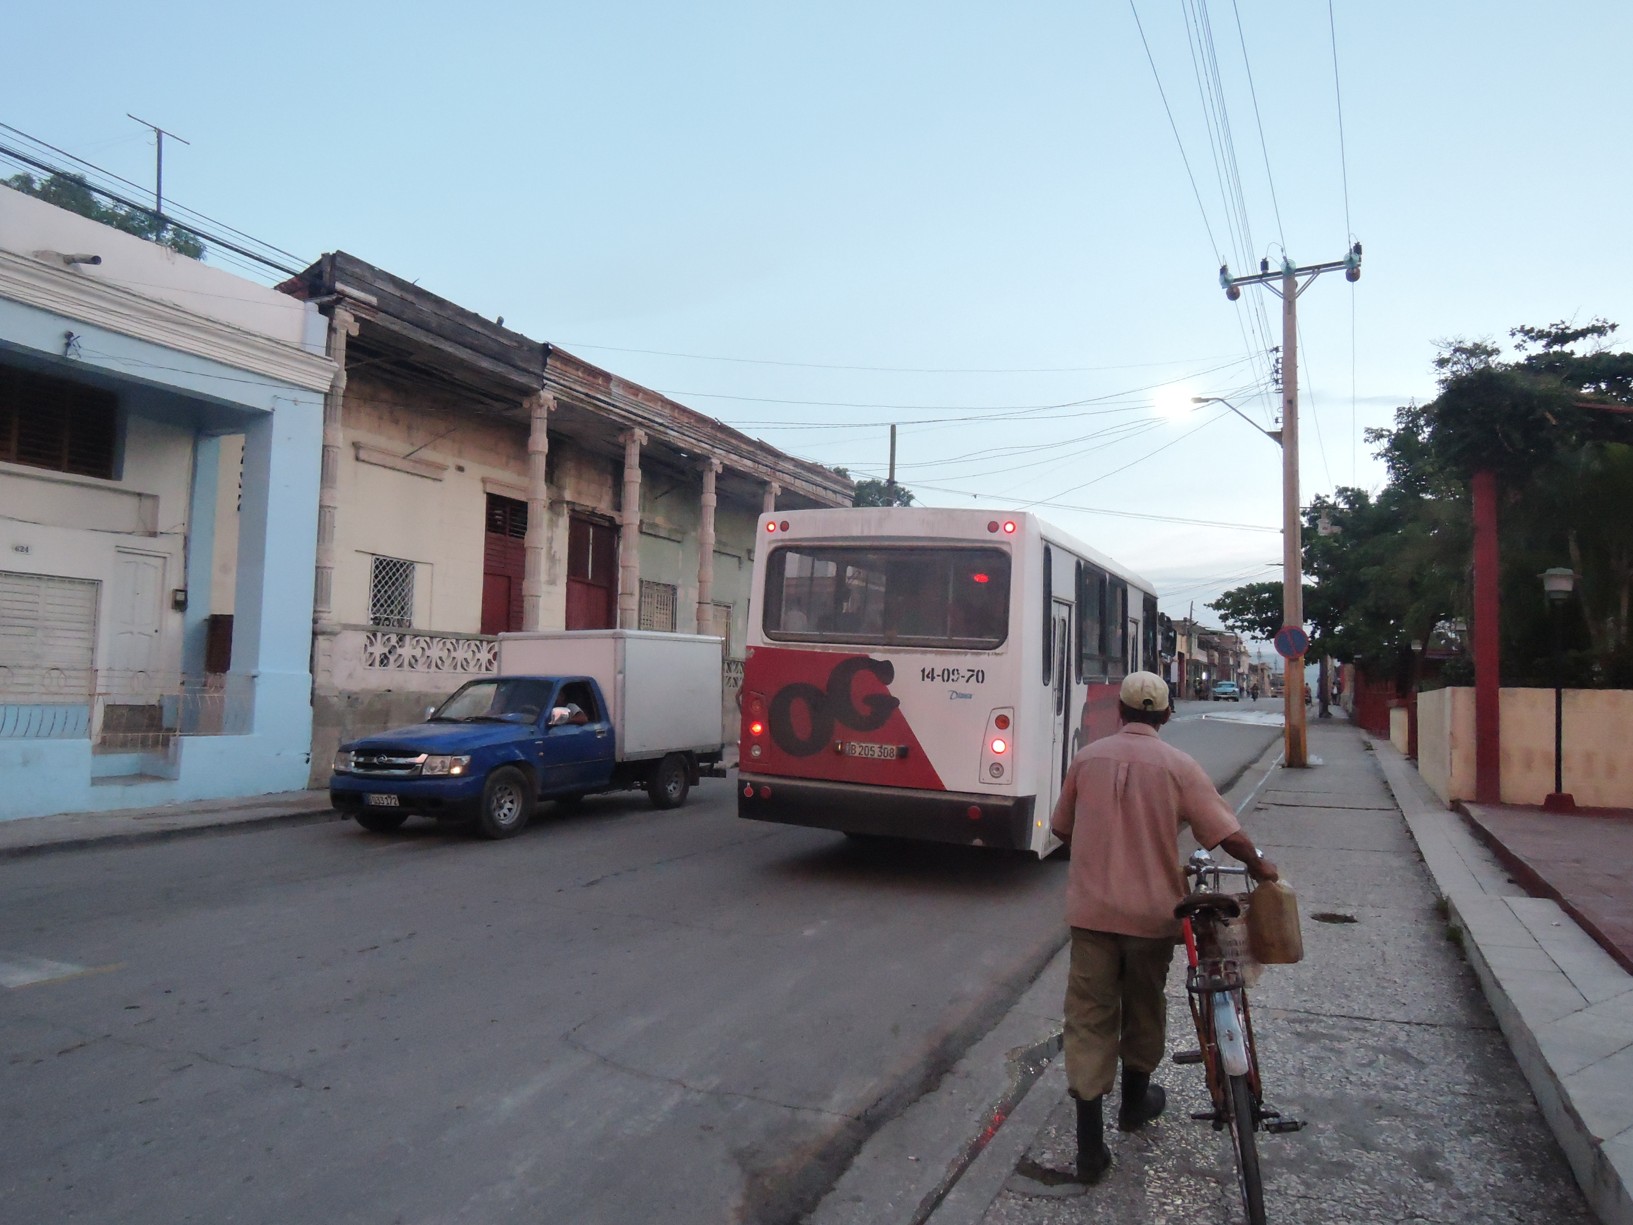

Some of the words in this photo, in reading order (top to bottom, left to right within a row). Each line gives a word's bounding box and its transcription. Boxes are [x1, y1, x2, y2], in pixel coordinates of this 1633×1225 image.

[920, 667, 985, 684] 14-09-70
[858, 745, 876, 757] 205
[877, 745, 895, 758] 308
